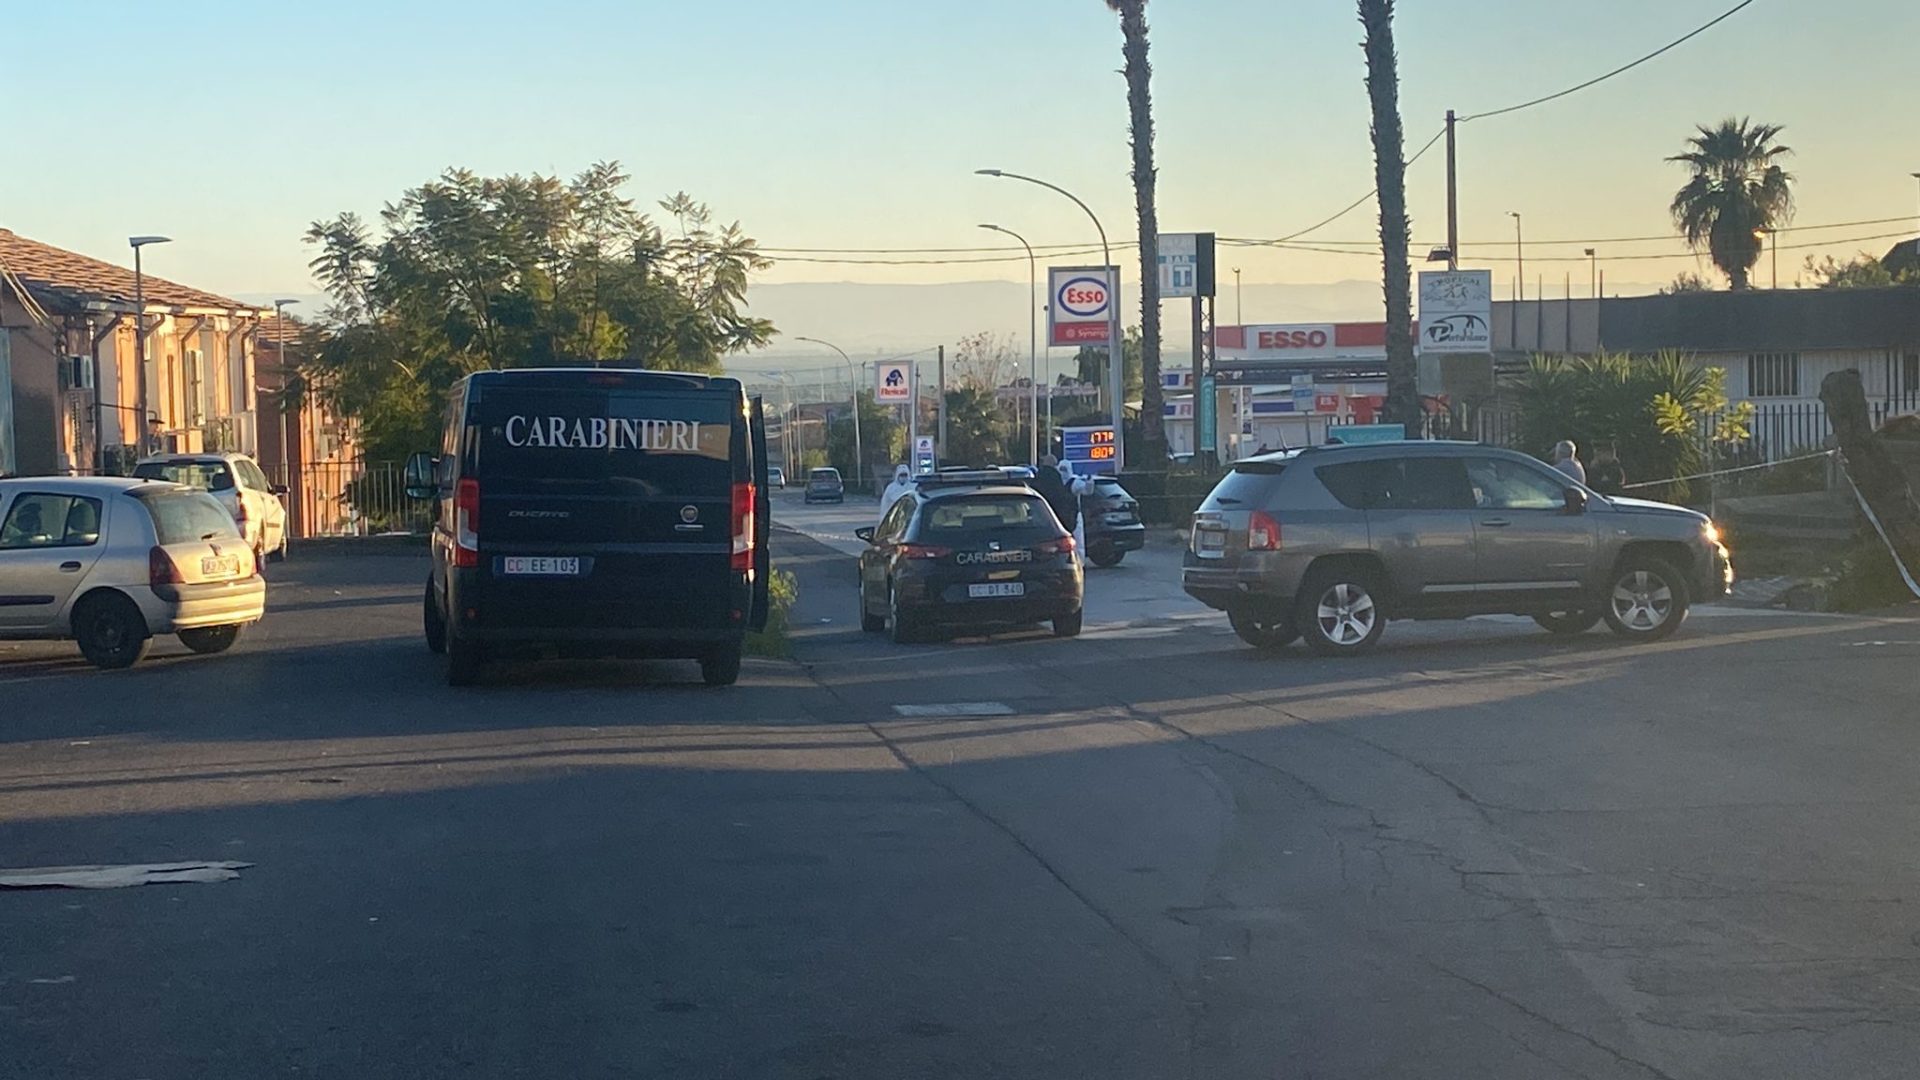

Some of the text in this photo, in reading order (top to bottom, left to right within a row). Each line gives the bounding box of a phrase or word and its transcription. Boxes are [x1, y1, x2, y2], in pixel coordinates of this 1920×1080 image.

[1166, 255, 1189, 264] BAR
[1258, 330, 1327, 349] ESSO
[505, 415, 701, 452] CARABINIERI
[956, 550, 1032, 565] CARABINIERI
[507, 558, 577, 573] CC EE 103
